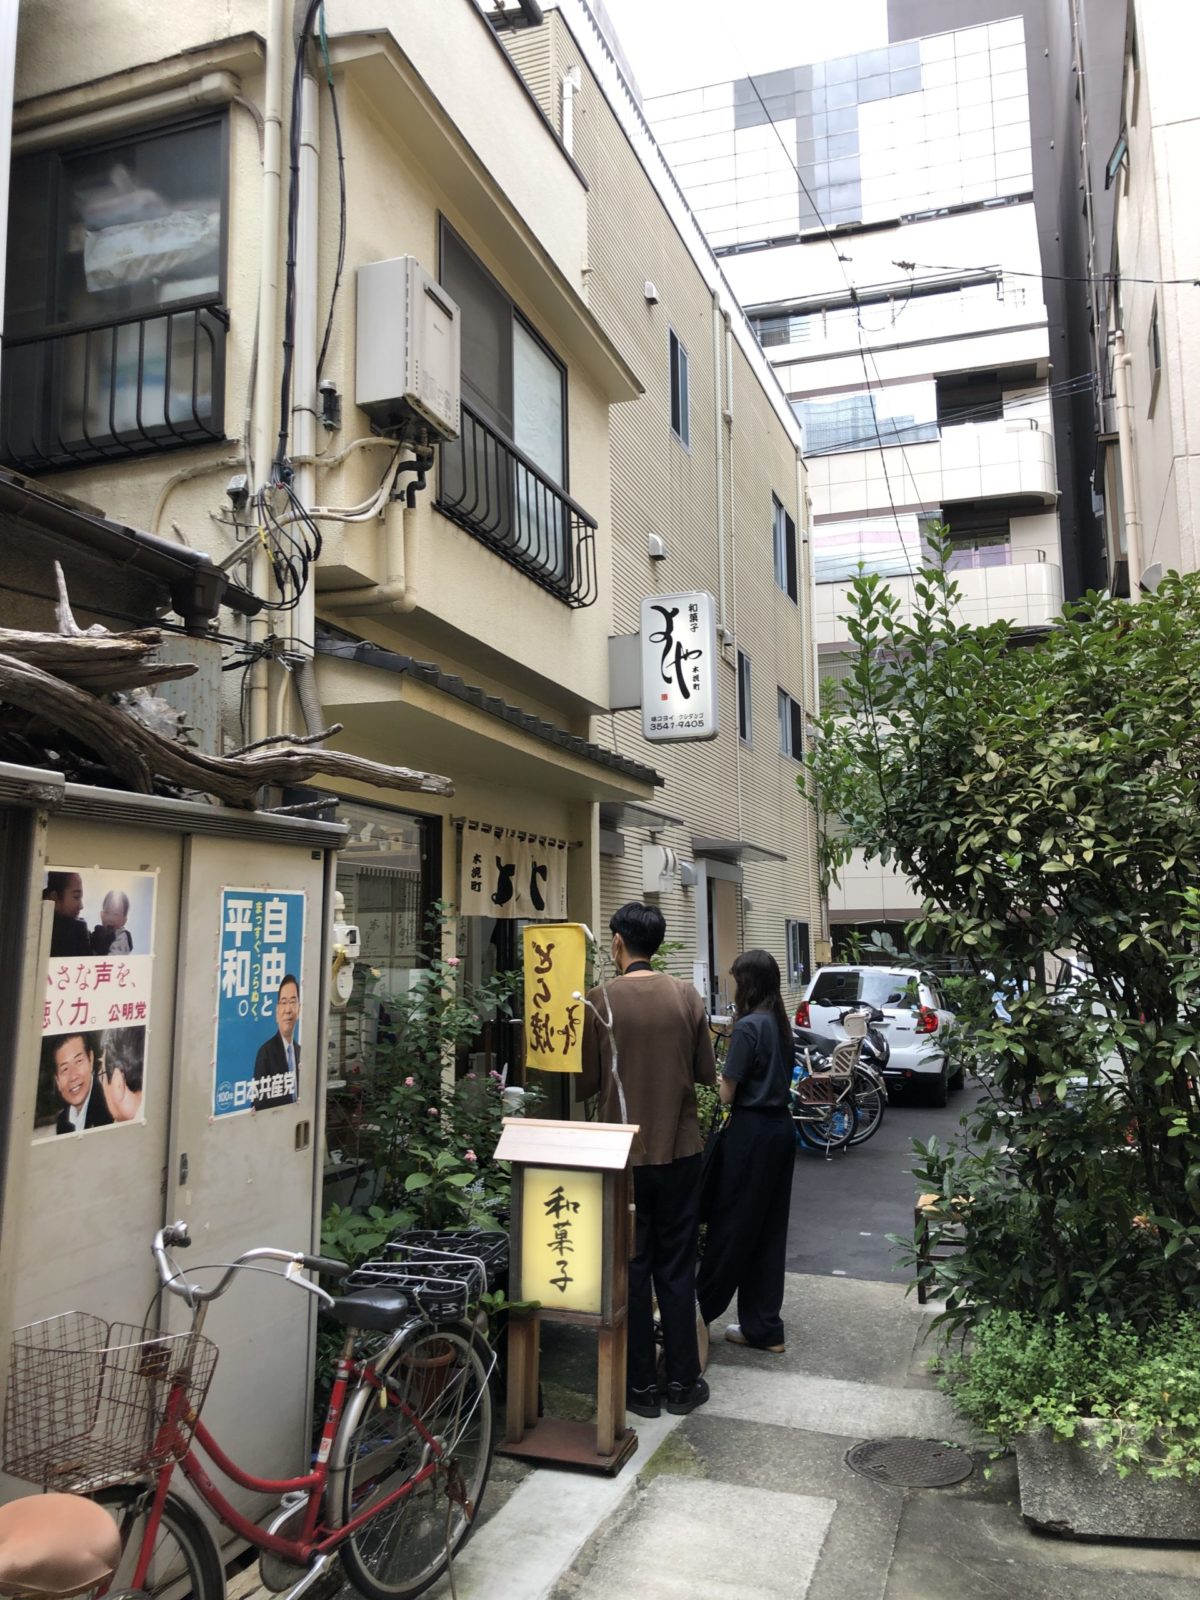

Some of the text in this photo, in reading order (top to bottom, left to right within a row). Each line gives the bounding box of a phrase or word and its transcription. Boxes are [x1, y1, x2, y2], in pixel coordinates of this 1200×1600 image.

[688, 603, 699, 633] 和菓子
[650, 720, 705, 730] 3541-9405
[222, 899, 254, 1017] 平和。
[261, 897, 288, 1017] 自由と
[108, 1001, 147, 1022] 公明党
[234, 1072, 295, 1106] 日本共産党
[544, 1185, 581, 1293] 和菓子
